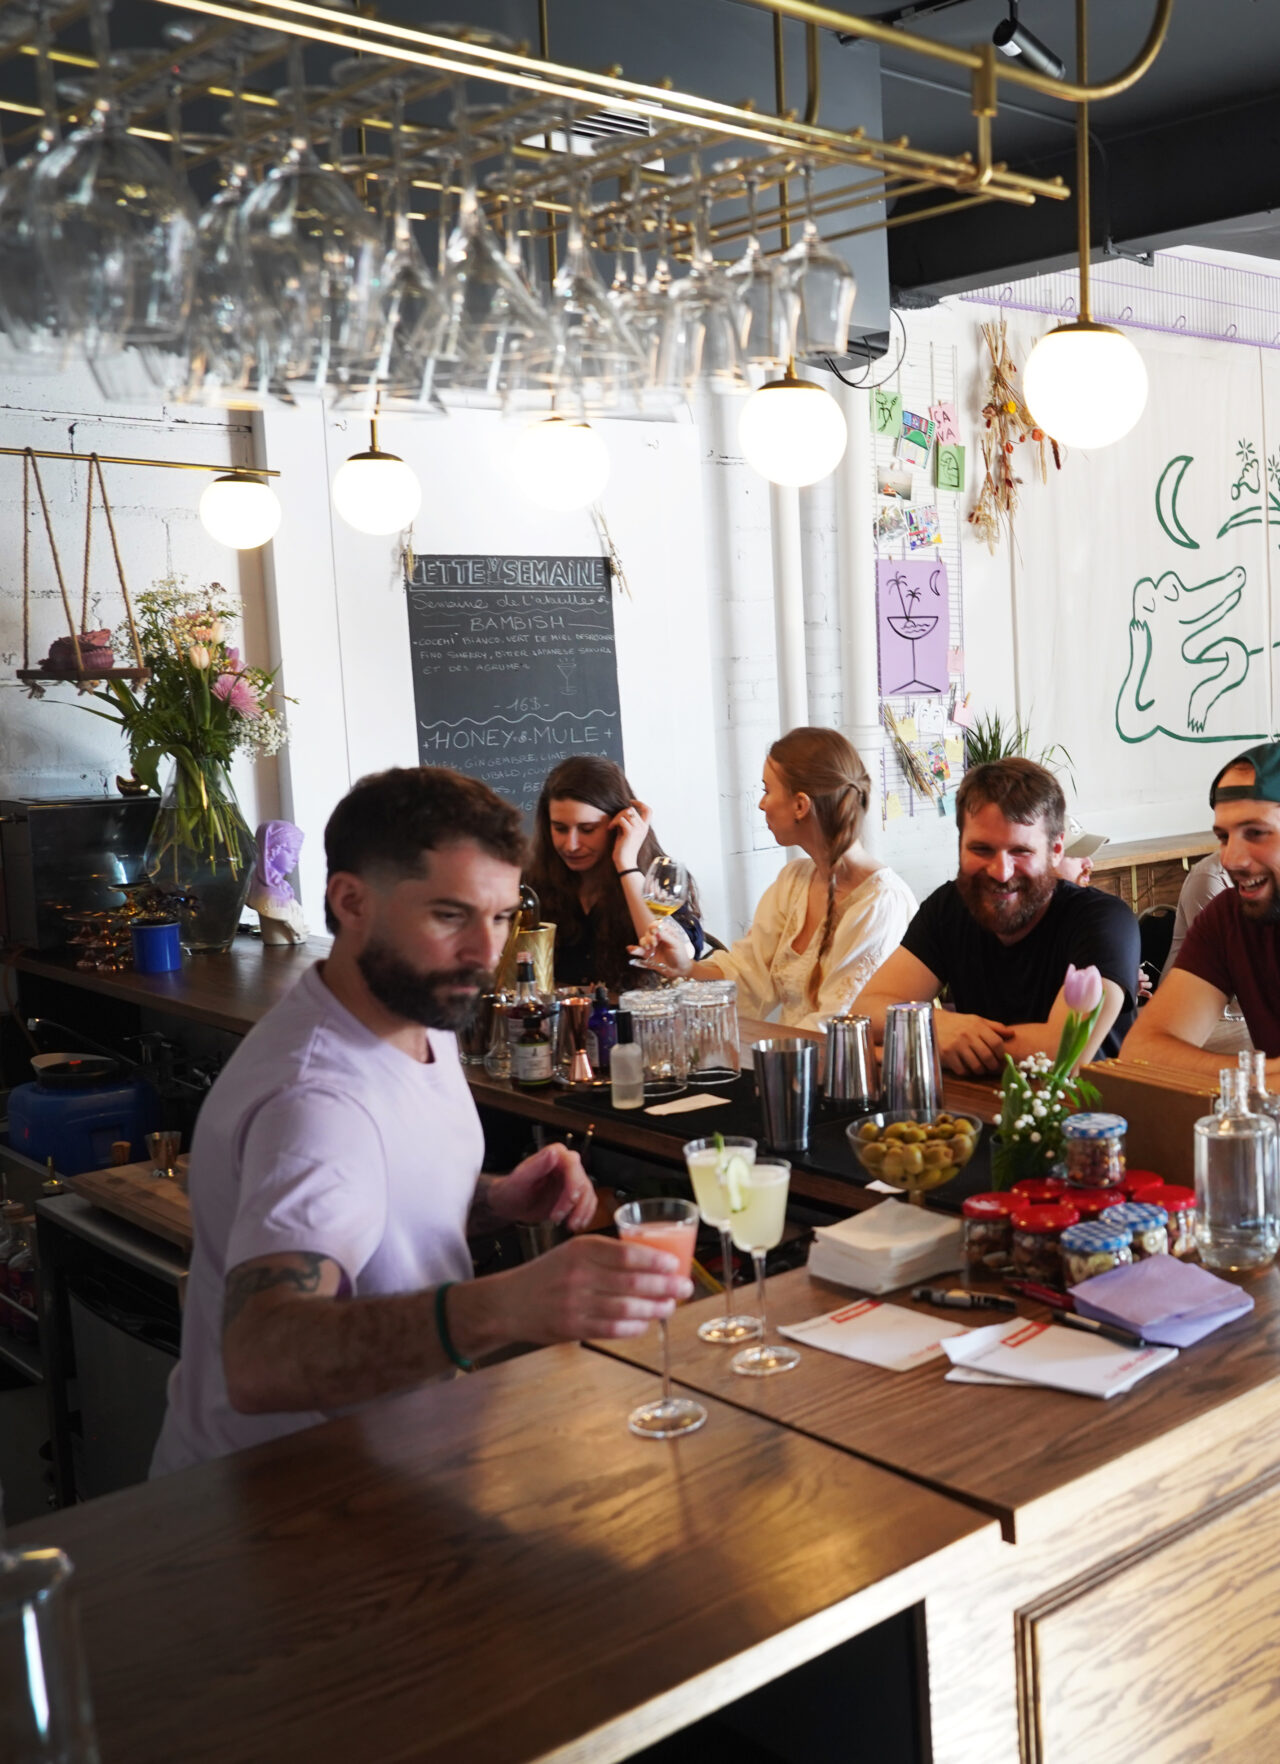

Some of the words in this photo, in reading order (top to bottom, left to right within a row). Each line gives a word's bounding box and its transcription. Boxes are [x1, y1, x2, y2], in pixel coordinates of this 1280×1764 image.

[937, 427, 956, 442] VA
[412, 593, 489, 610] Semaine
[497, 594, 520, 607] de
[471, 615, 565, 631] BAMBISH
[534, 635, 548, 643] DE
[428, 729, 514, 749] HONEY
[533, 726, 600, 744] MULE
